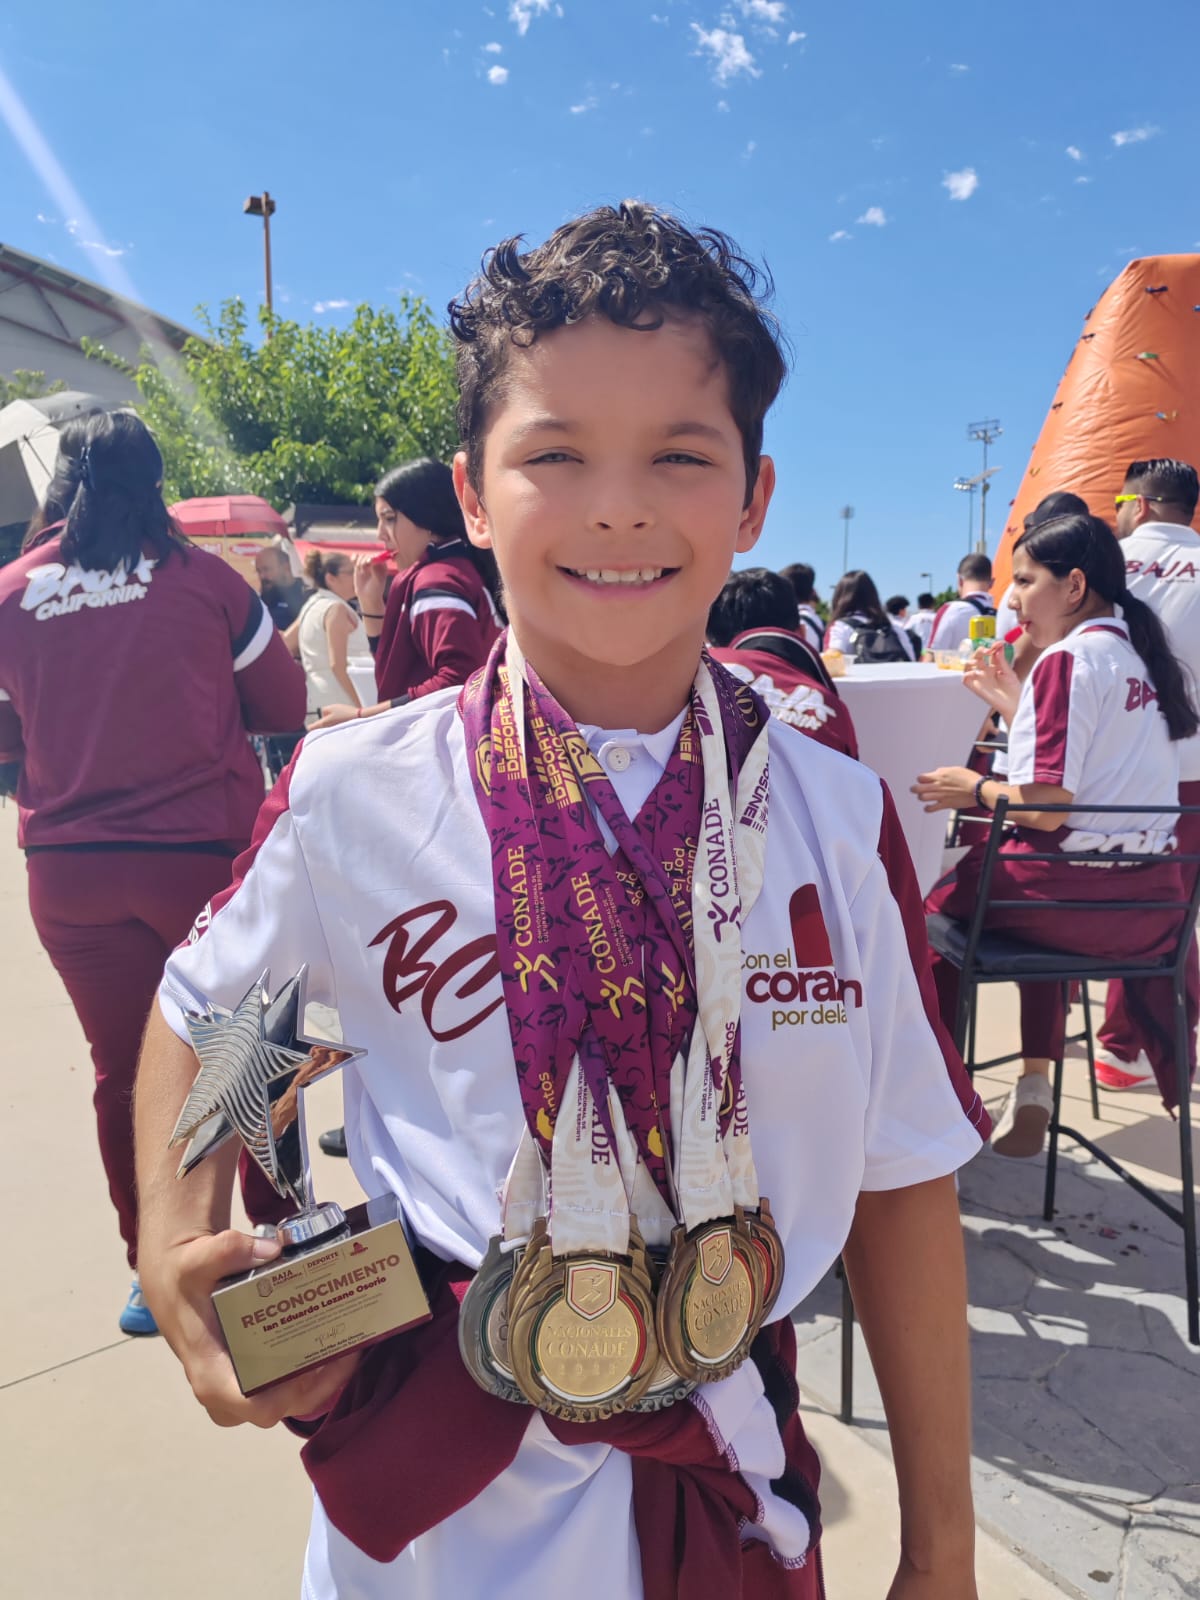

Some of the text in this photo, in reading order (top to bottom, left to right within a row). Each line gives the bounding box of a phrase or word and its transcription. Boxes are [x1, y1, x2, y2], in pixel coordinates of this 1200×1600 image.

[1126, 560, 1200, 578] BAJA
[35, 583, 148, 621] CALIFORNIA
[1125, 678, 1159, 712] BA
[500, 696, 520, 773] DEPORTE
[497, 759, 506, 773] EL
[530, 717, 567, 799] DEPORTE
[545, 789, 555, 804] EL
[673, 848, 686, 875] por
[704, 798, 729, 897] CONADE
[507, 845, 533, 947] CONADE
[571, 872, 616, 974] CONADE
[367, 899, 505, 1043] BC
[741, 947, 792, 970] on el
[746, 970, 863, 1008] coran
[772, 1003, 848, 1031] por dela
[307, 1251, 339, 1269] DEPORTE
[241, 1254, 400, 1329] RECONOCIMIENTO
[263, 1322, 279, 1333] Ian
[280, 1304, 320, 1326] Eduardo
[321, 1290, 354, 1309] Lozano
[356, 1276, 387, 1293] Osorio
[694, 1294, 747, 1331] CONADE
[546, 1340, 629, 1359] CONADE
[548, 1325, 632, 1339] NACIONALES
